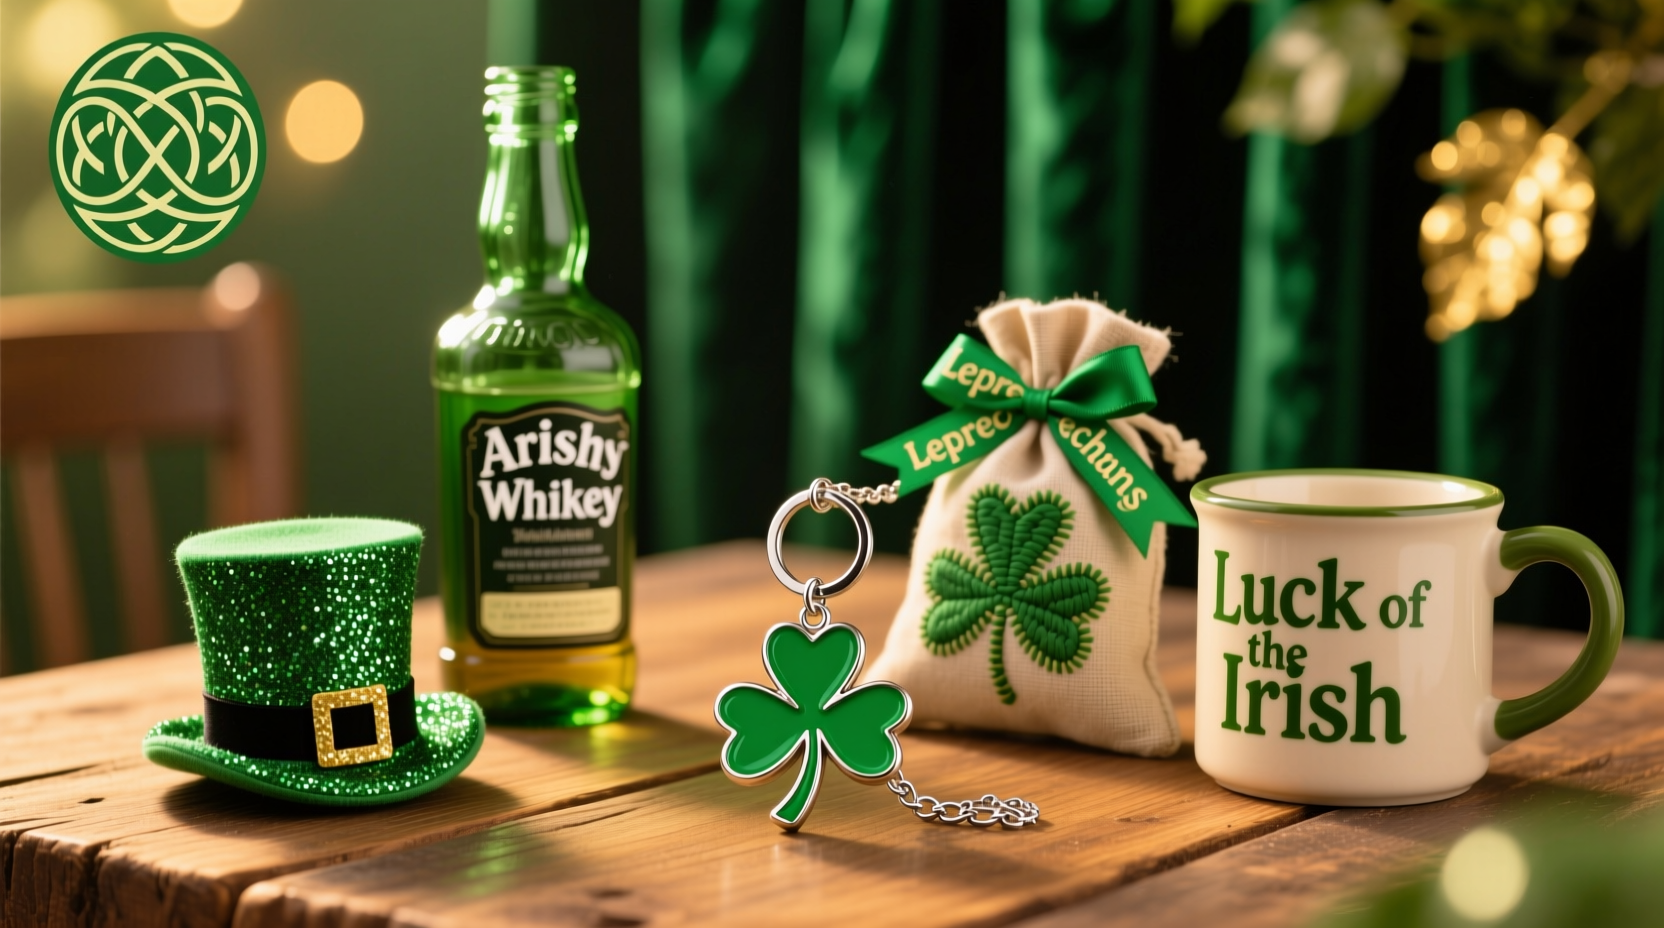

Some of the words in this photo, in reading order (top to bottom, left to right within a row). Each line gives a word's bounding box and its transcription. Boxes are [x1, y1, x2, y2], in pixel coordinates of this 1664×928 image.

[479, 418, 629, 481] Arishy
[477, 477, 623, 528] Whikey
[1213, 549, 1367, 631] Luck
[1379, 579, 1432, 629] of
[1248, 630, 1308, 674] the
[1221, 652, 1407, 745] Irish
